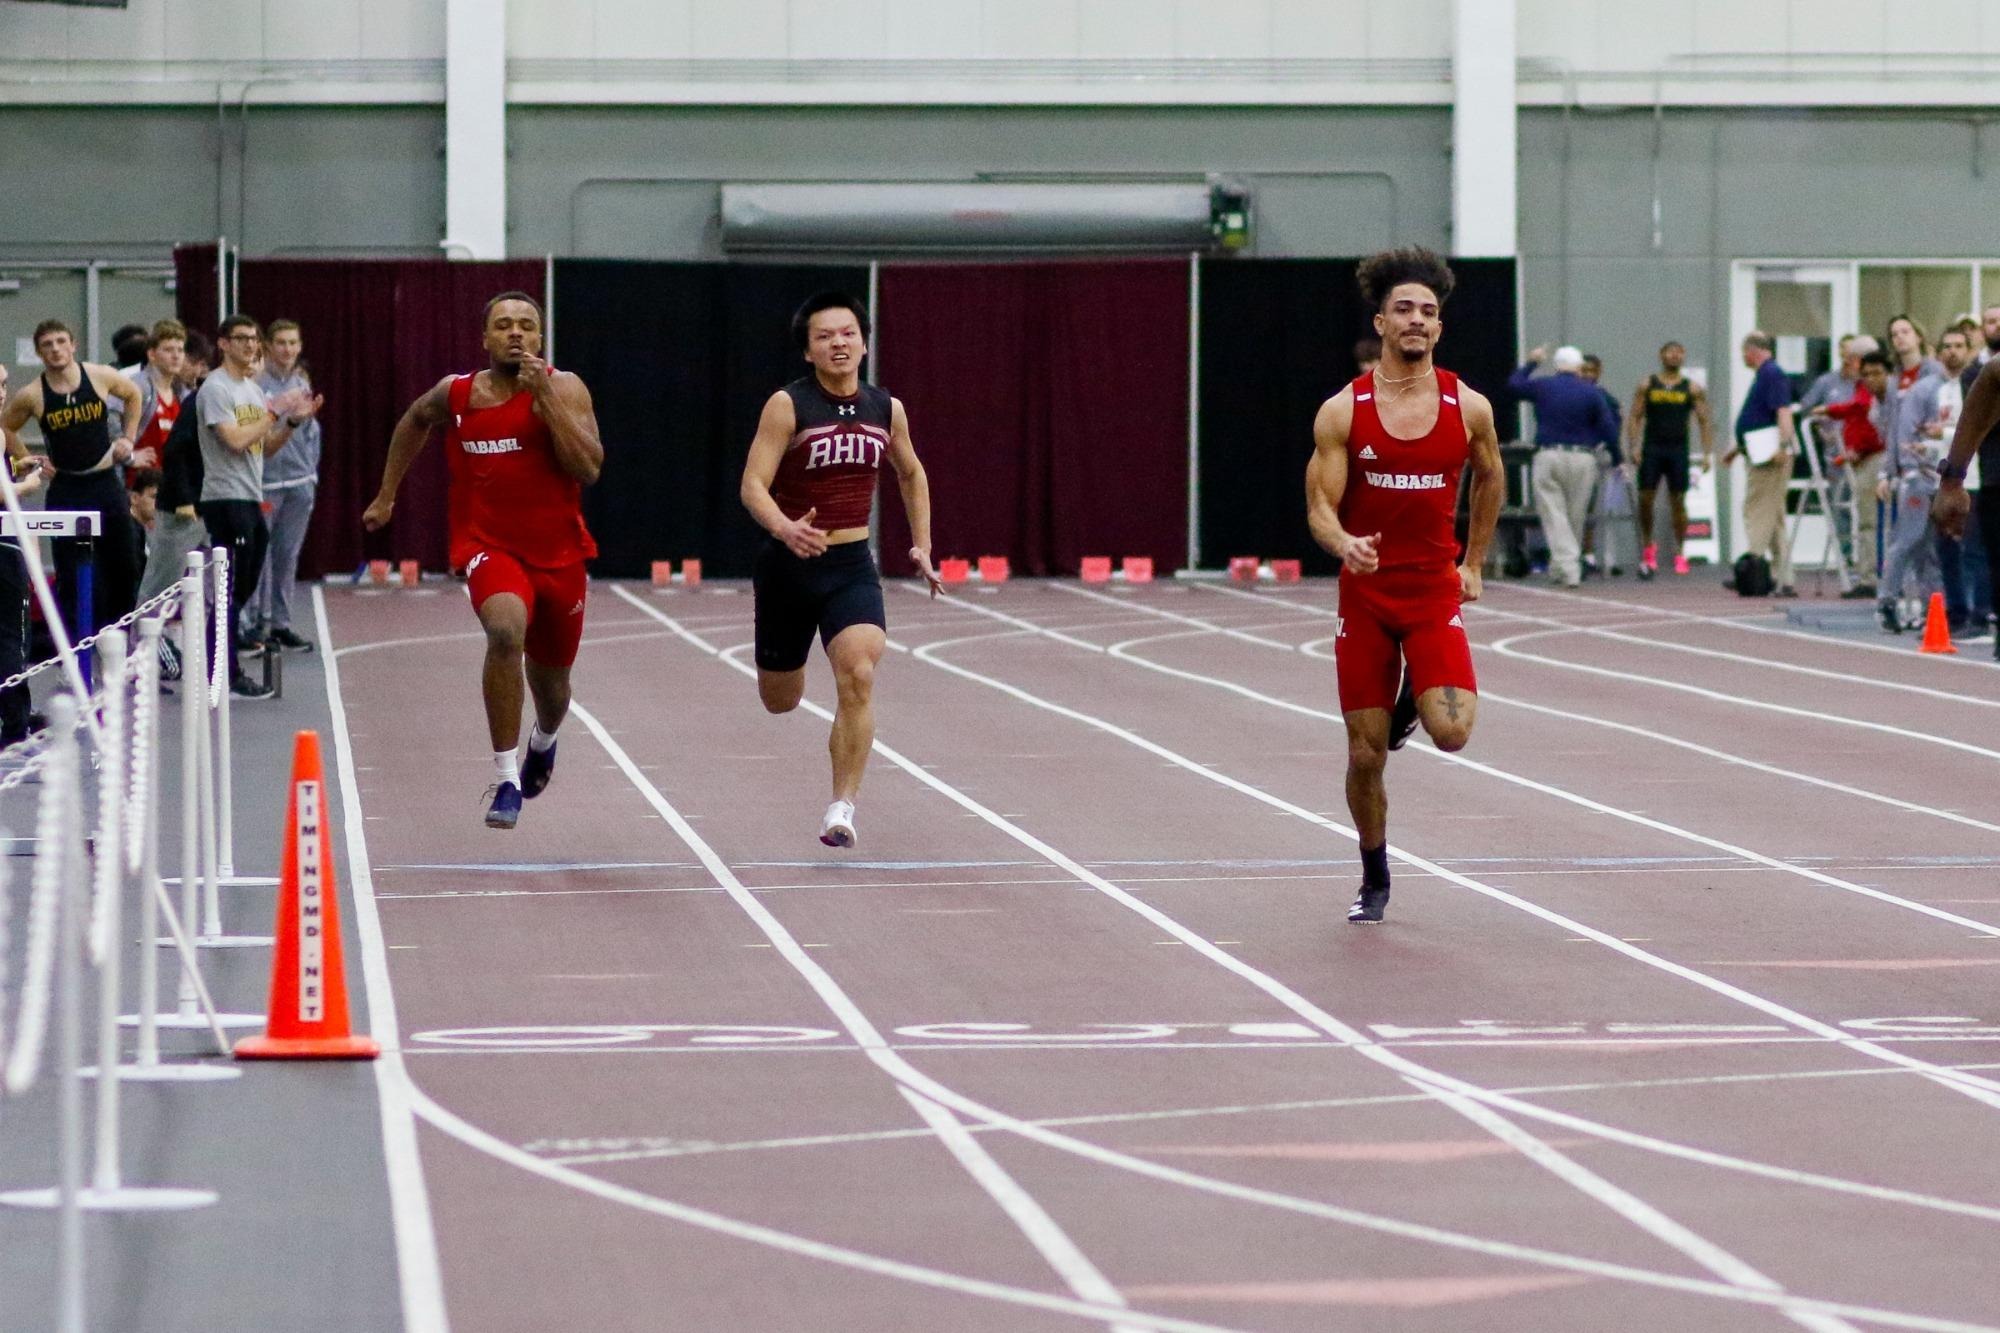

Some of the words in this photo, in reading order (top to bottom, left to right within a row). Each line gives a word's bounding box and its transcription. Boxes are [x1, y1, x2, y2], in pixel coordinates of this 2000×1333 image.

[47, 401, 103, 430] DEPAUW
[805, 433, 885, 470] RHIT
[1365, 471, 1446, 490] WABASH.
[27, 521, 64, 530] UCS
